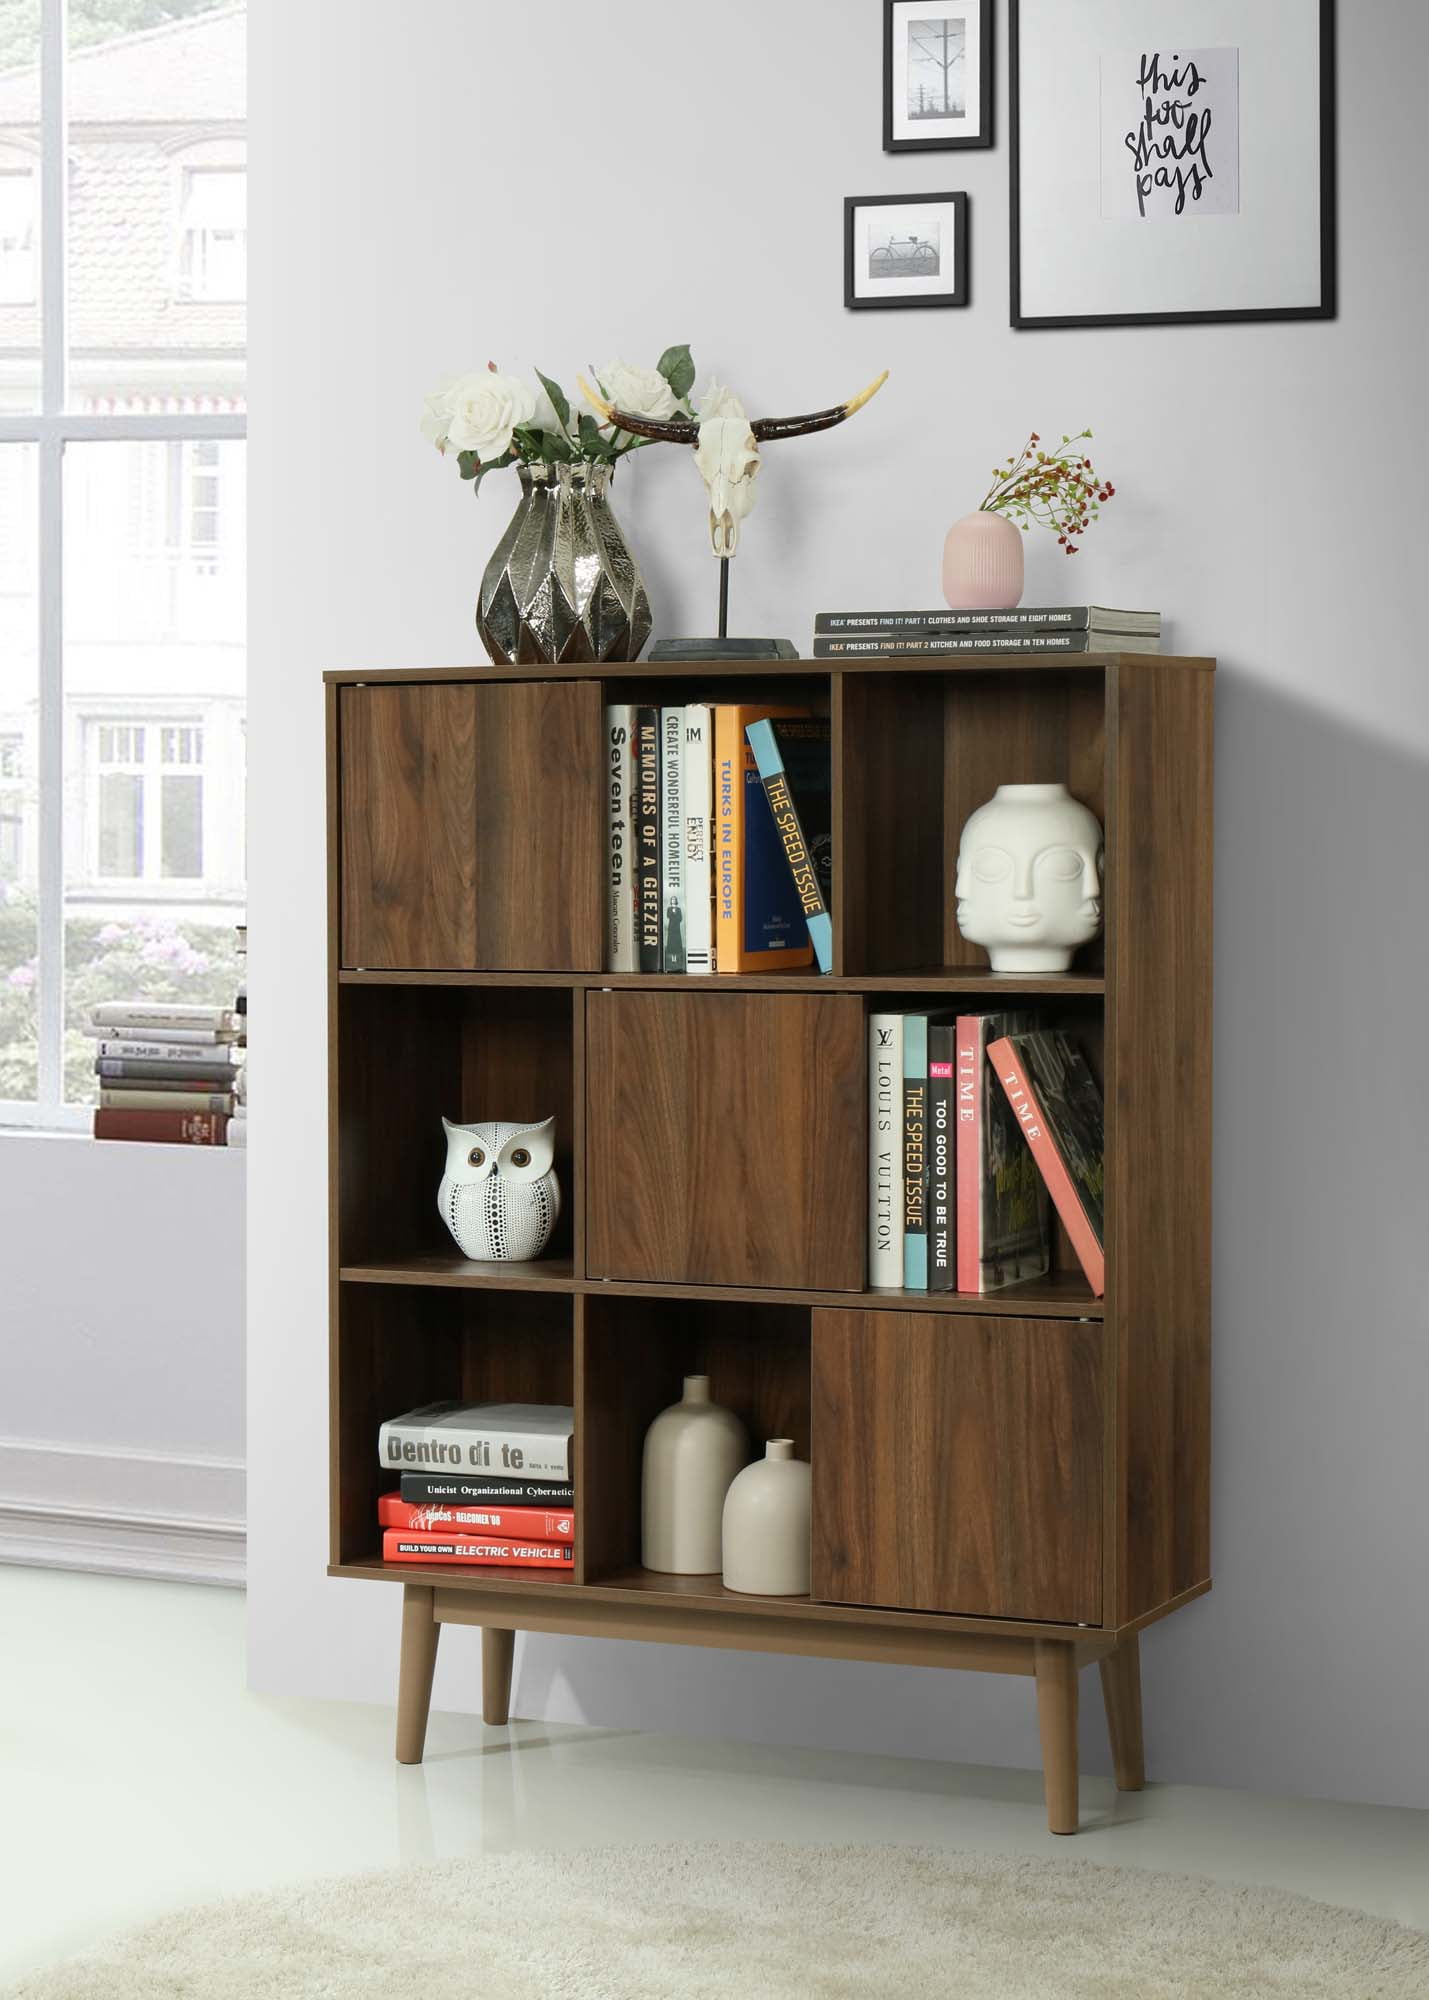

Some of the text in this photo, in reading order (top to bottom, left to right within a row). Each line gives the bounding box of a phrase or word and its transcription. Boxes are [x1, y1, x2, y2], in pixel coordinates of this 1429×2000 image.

[1135, 53, 1207, 100] this
[1125, 107, 1213, 178] shall
[1143, 96, 1193, 141] too
[1136, 163, 1207, 218] pass
[846, 618, 879, 626] PRESENTS
[879, 617, 894, 625] FIND
[895, 617, 904, 625] IT!
[904, 616, 921, 625] PART
[928, 616, 956, 625] CLOTHES
[957, 615, 971, 624] AND
[971, 615, 988, 624] SHOE
[990, 614, 1019, 623] STORAGE
[1020, 614, 1028, 622] IN
[1028, 614, 1047, 622] EIGHT
[1048, 613, 1072, 622] HOMES
[846, 642, 879, 651] PRESENTS
[880, 642, 895, 650] FIND
[896, 642, 905, 650] IT!
[906, 641, 923, 649] PART
[924, 641, 929, 649] 2
[930, 641, 959, 649] KITCHEN
[959, 640, 973, 648] AND
[974, 640, 991, 648] FOOD
[992, 639, 1021, 647] STORAGE
[1023, 639, 1031, 647] IN
[1032, 638, 1045, 646] TEN
[1046, 638, 1070, 646] HOMES
[666, 716, 681, 889] CREATE WONDERFUL HOMELIFE
[641, 726, 658, 947] MEMOIRS OF A GEEZER
[687, 816, 697, 863] ENJOY
[696, 816, 704, 863] PERFECT
[721, 760, 733, 920] TURKS IN EUROPE
[767, 778, 822, 914] THE SPEED ISSUE
[960, 1046, 974, 1121] TIME
[1002, 1071, 1042, 1141] TIME
[877, 1060, 892, 1251] LOUIS VUITTON
[906, 1086, 924, 1227] THE SPEED ISSUE
[935, 1099, 947, 1268] TOO GOOD TO BE TRUE
[387, 1436, 524, 1470] Dentro di te
[427, 1485, 457, 1495] Unicist
[460, 1486, 523, 1497] Organizational
[399, 1544, 419, 1553] BUILD
[419, 1544, 437, 1553] YOUR
[437, 1545, 453, 1554] OWN
[455, 1545, 510, 1558] ELECTRIC
[512, 1547, 561, 1559] VEHICLE
